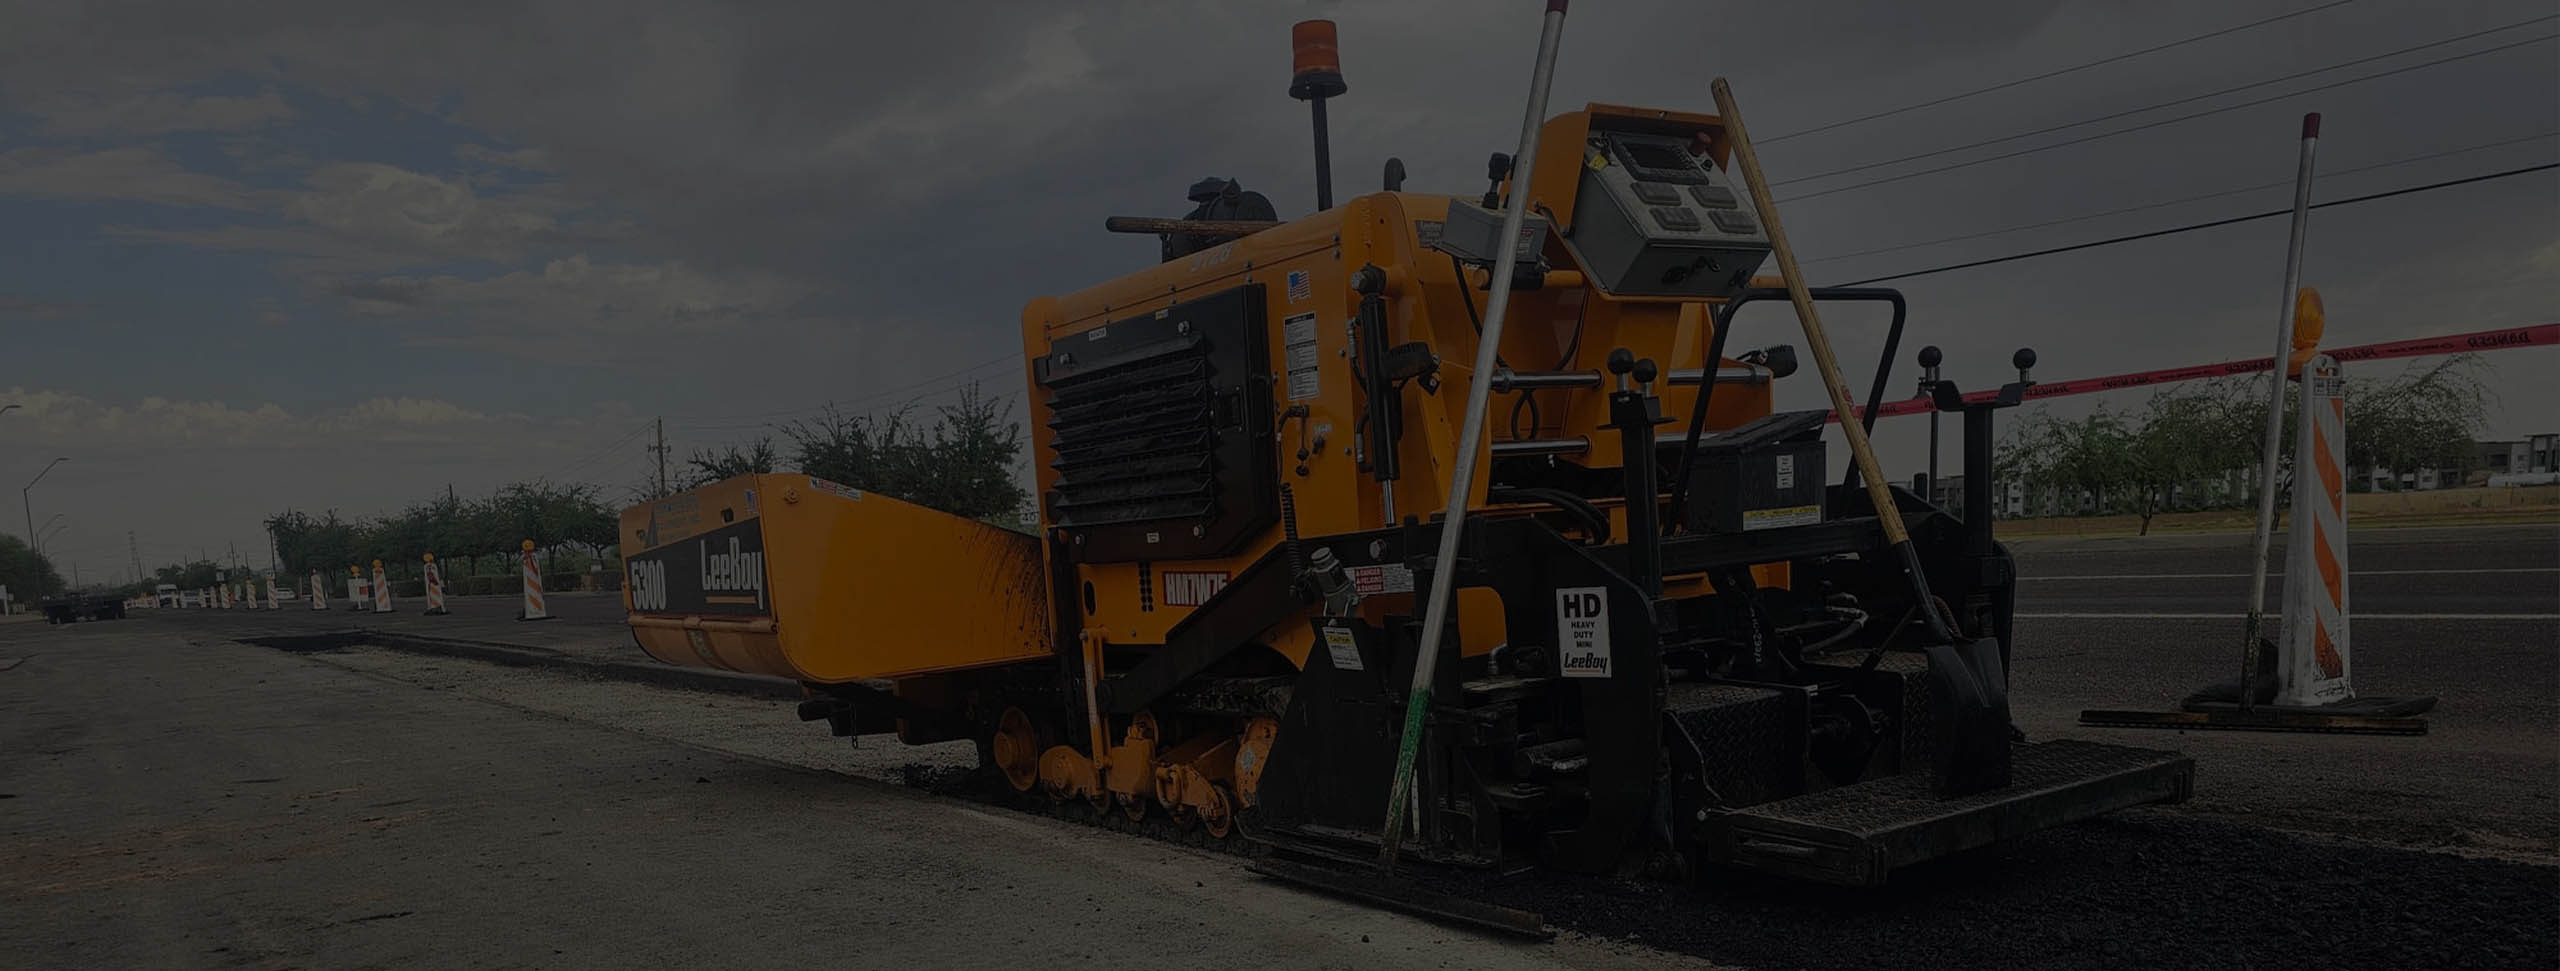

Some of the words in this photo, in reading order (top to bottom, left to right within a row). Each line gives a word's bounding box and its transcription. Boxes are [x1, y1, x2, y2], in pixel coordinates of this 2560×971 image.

[701, 536, 763, 609] LeeBoy
[630, 559, 667, 610] 5300
[1563, 593, 1601, 618] HD
[1571, 621, 1595, 629] HEAVY
[1574, 631, 1593, 639] DUTY
[1576, 640, 1592, 648] MINI
[1563, 652, 1608, 673] LeeBoy
